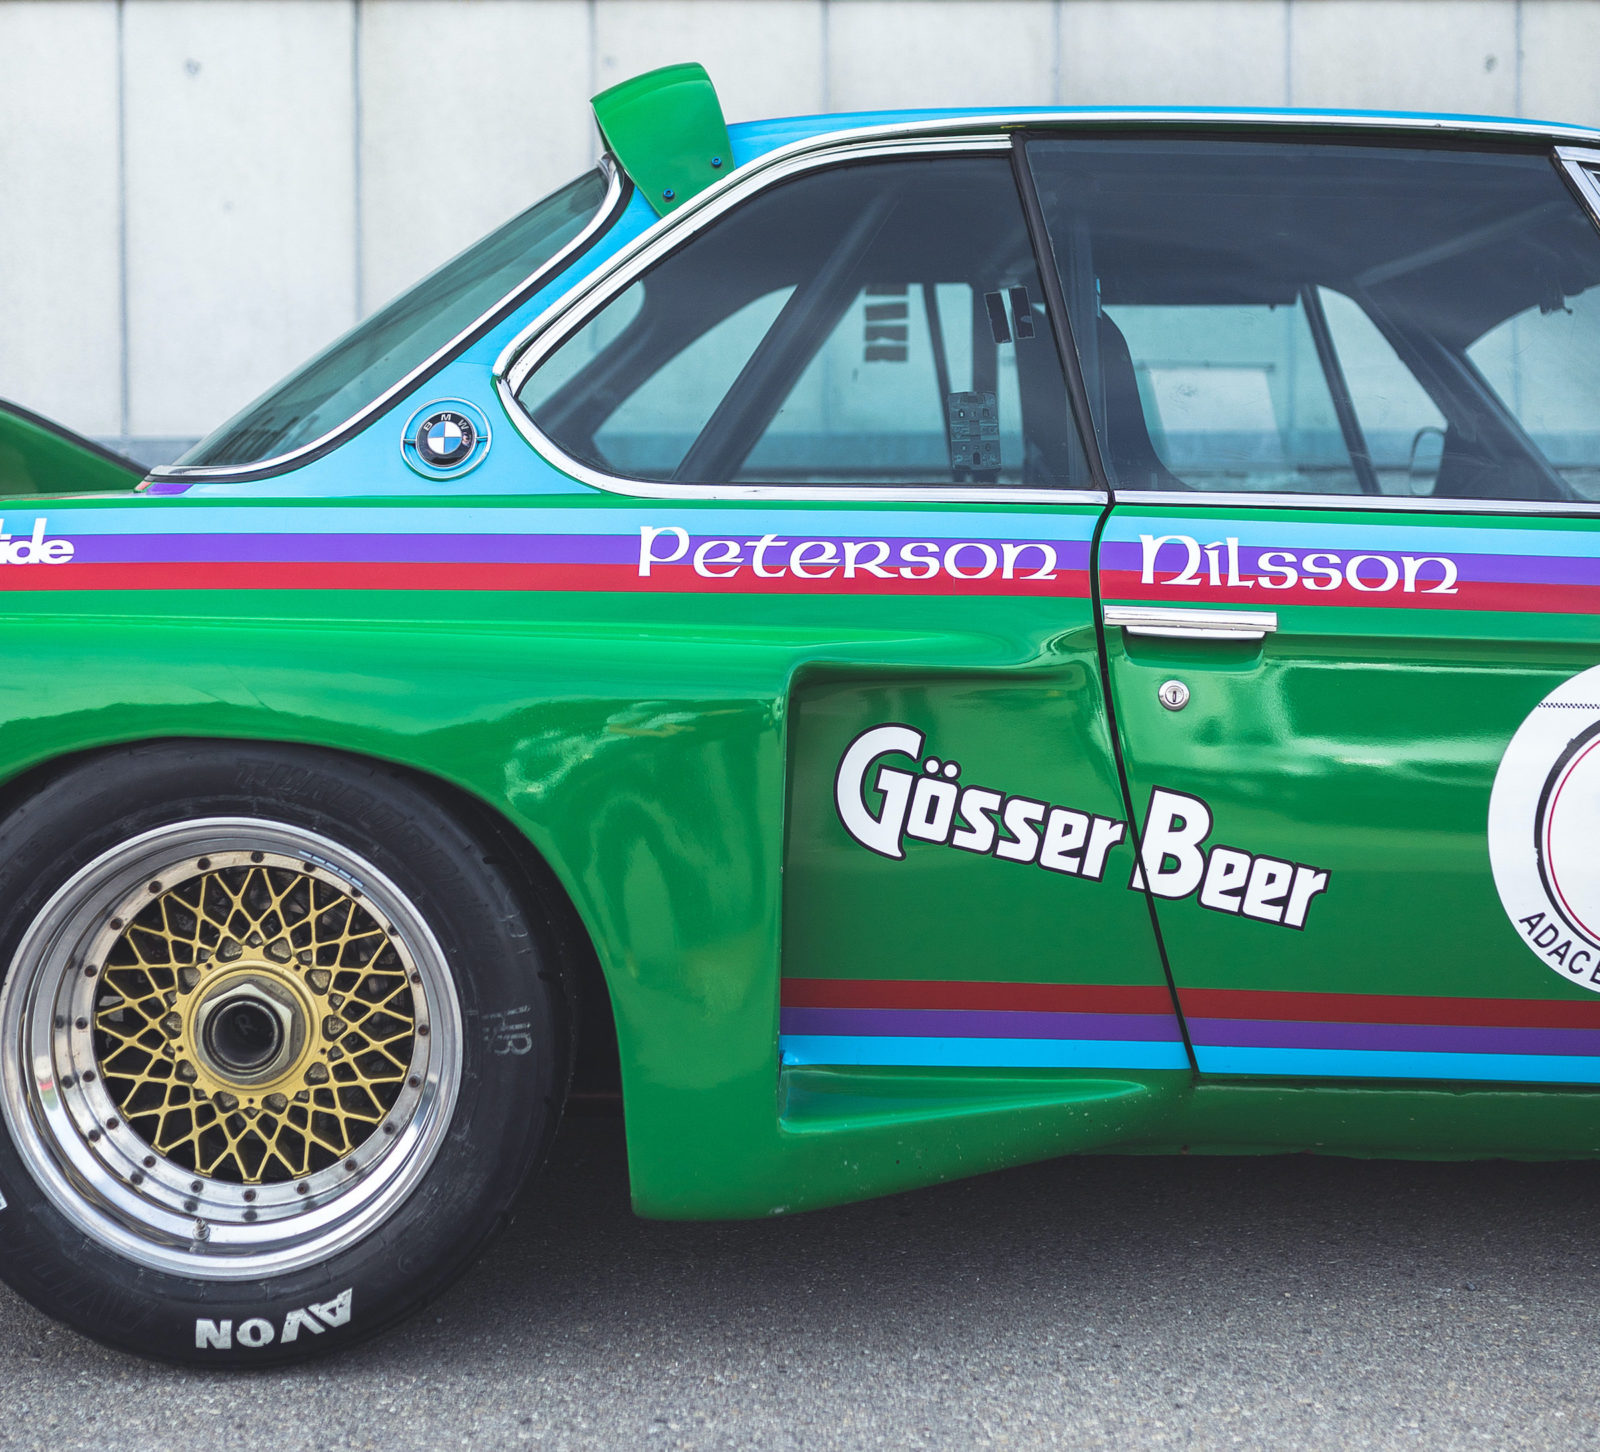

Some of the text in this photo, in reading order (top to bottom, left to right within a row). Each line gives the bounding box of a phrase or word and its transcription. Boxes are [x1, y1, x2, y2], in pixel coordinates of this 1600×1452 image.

[423, 412, 470, 431] BMW
[0, 517, 75, 565] ide
[834, 722, 1333, 932] Gösser Beer
[195, 1287, 354, 1350] AVON
